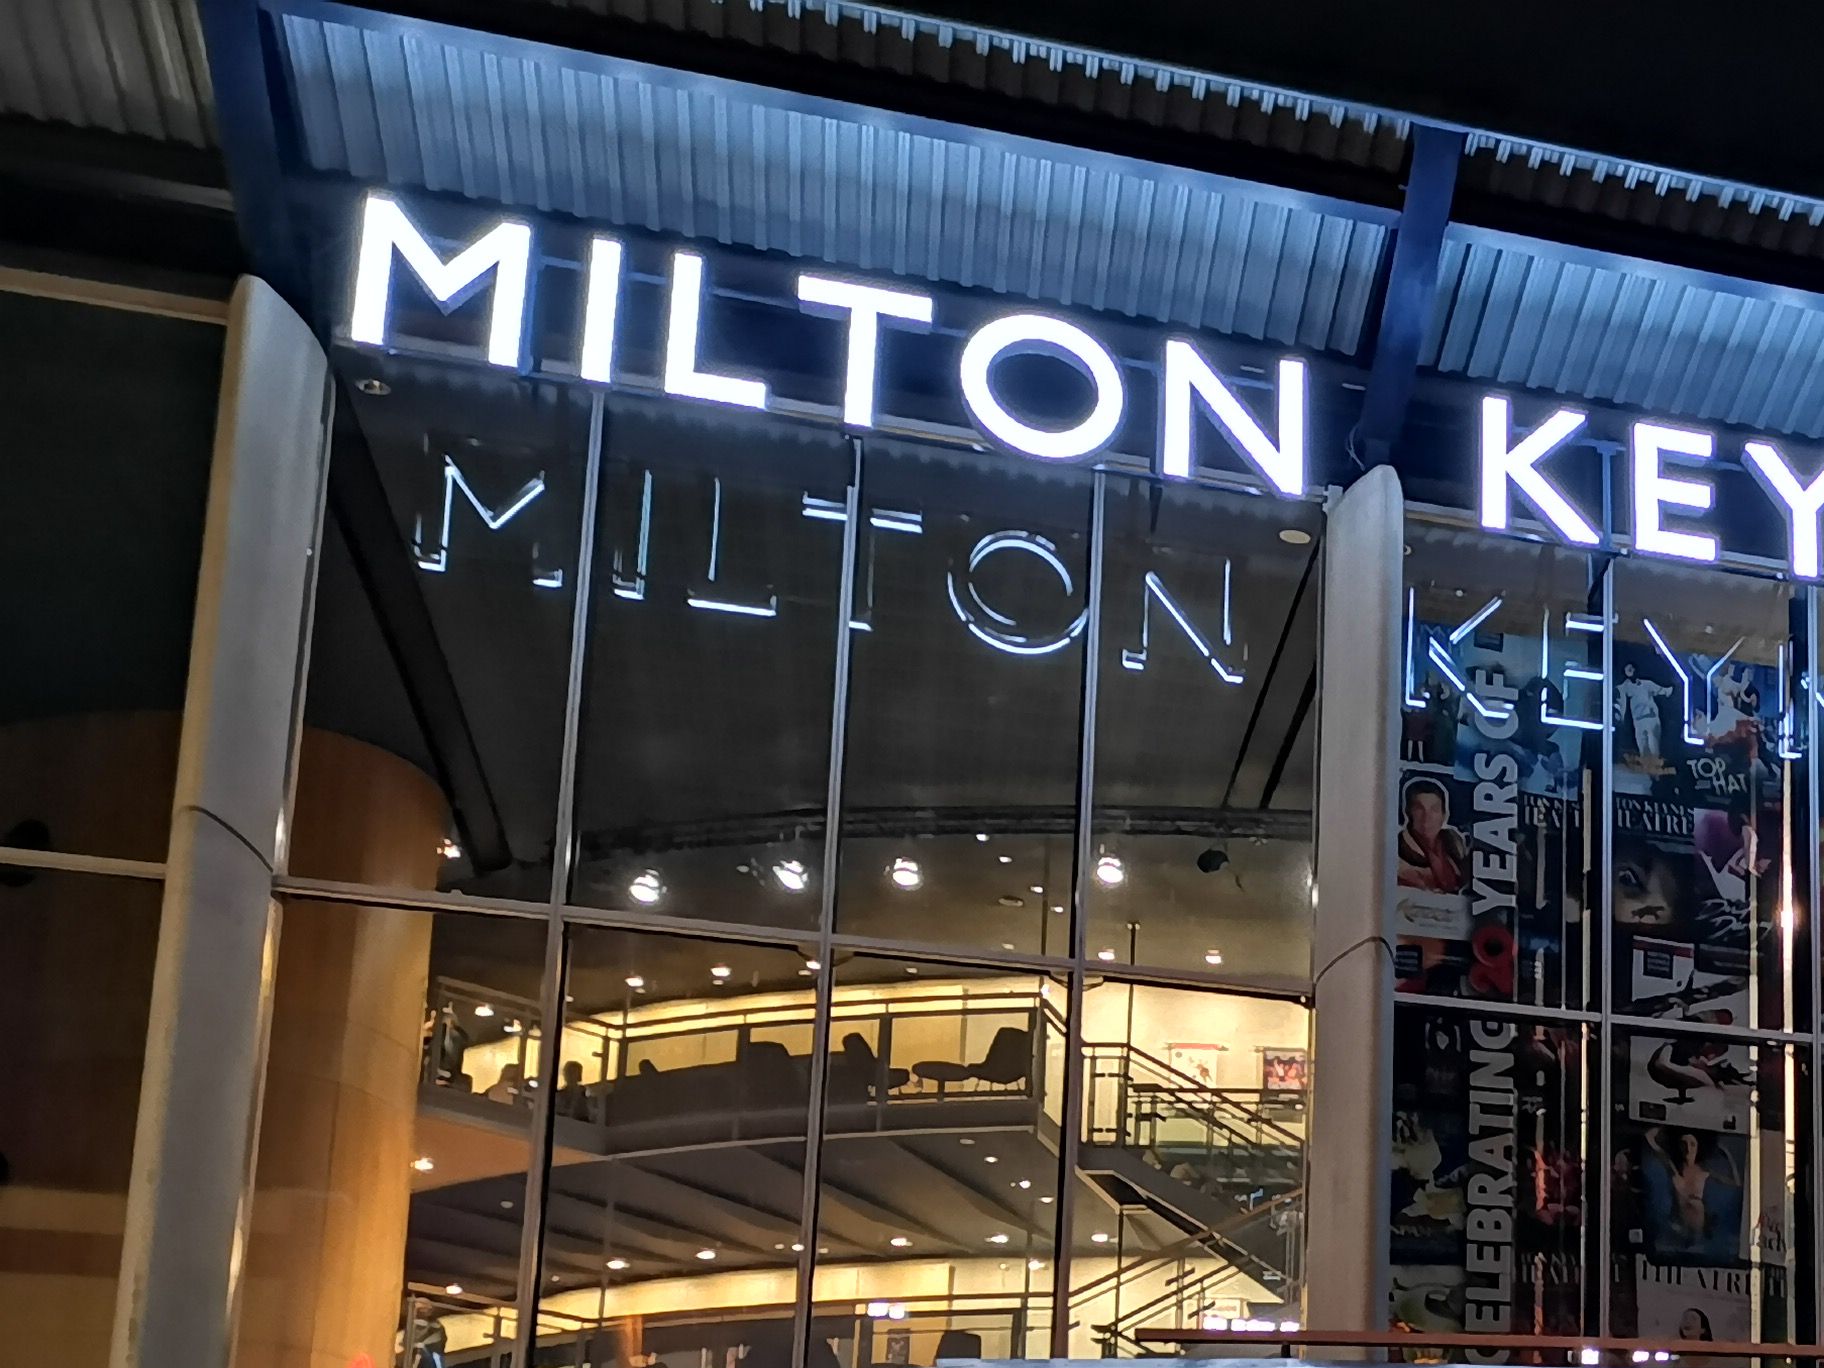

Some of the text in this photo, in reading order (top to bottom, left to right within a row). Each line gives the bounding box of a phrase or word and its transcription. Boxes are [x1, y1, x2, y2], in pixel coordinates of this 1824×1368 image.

[349, 193, 1308, 496] MILTON
[1474, 669, 1519, 740] OF
[1686, 757, 1726, 779] TOP
[1711, 773, 1748, 796] HAT
[1471, 752, 1519, 917] YEARS
[1464, 1017, 1517, 1366] CELEBRATING
